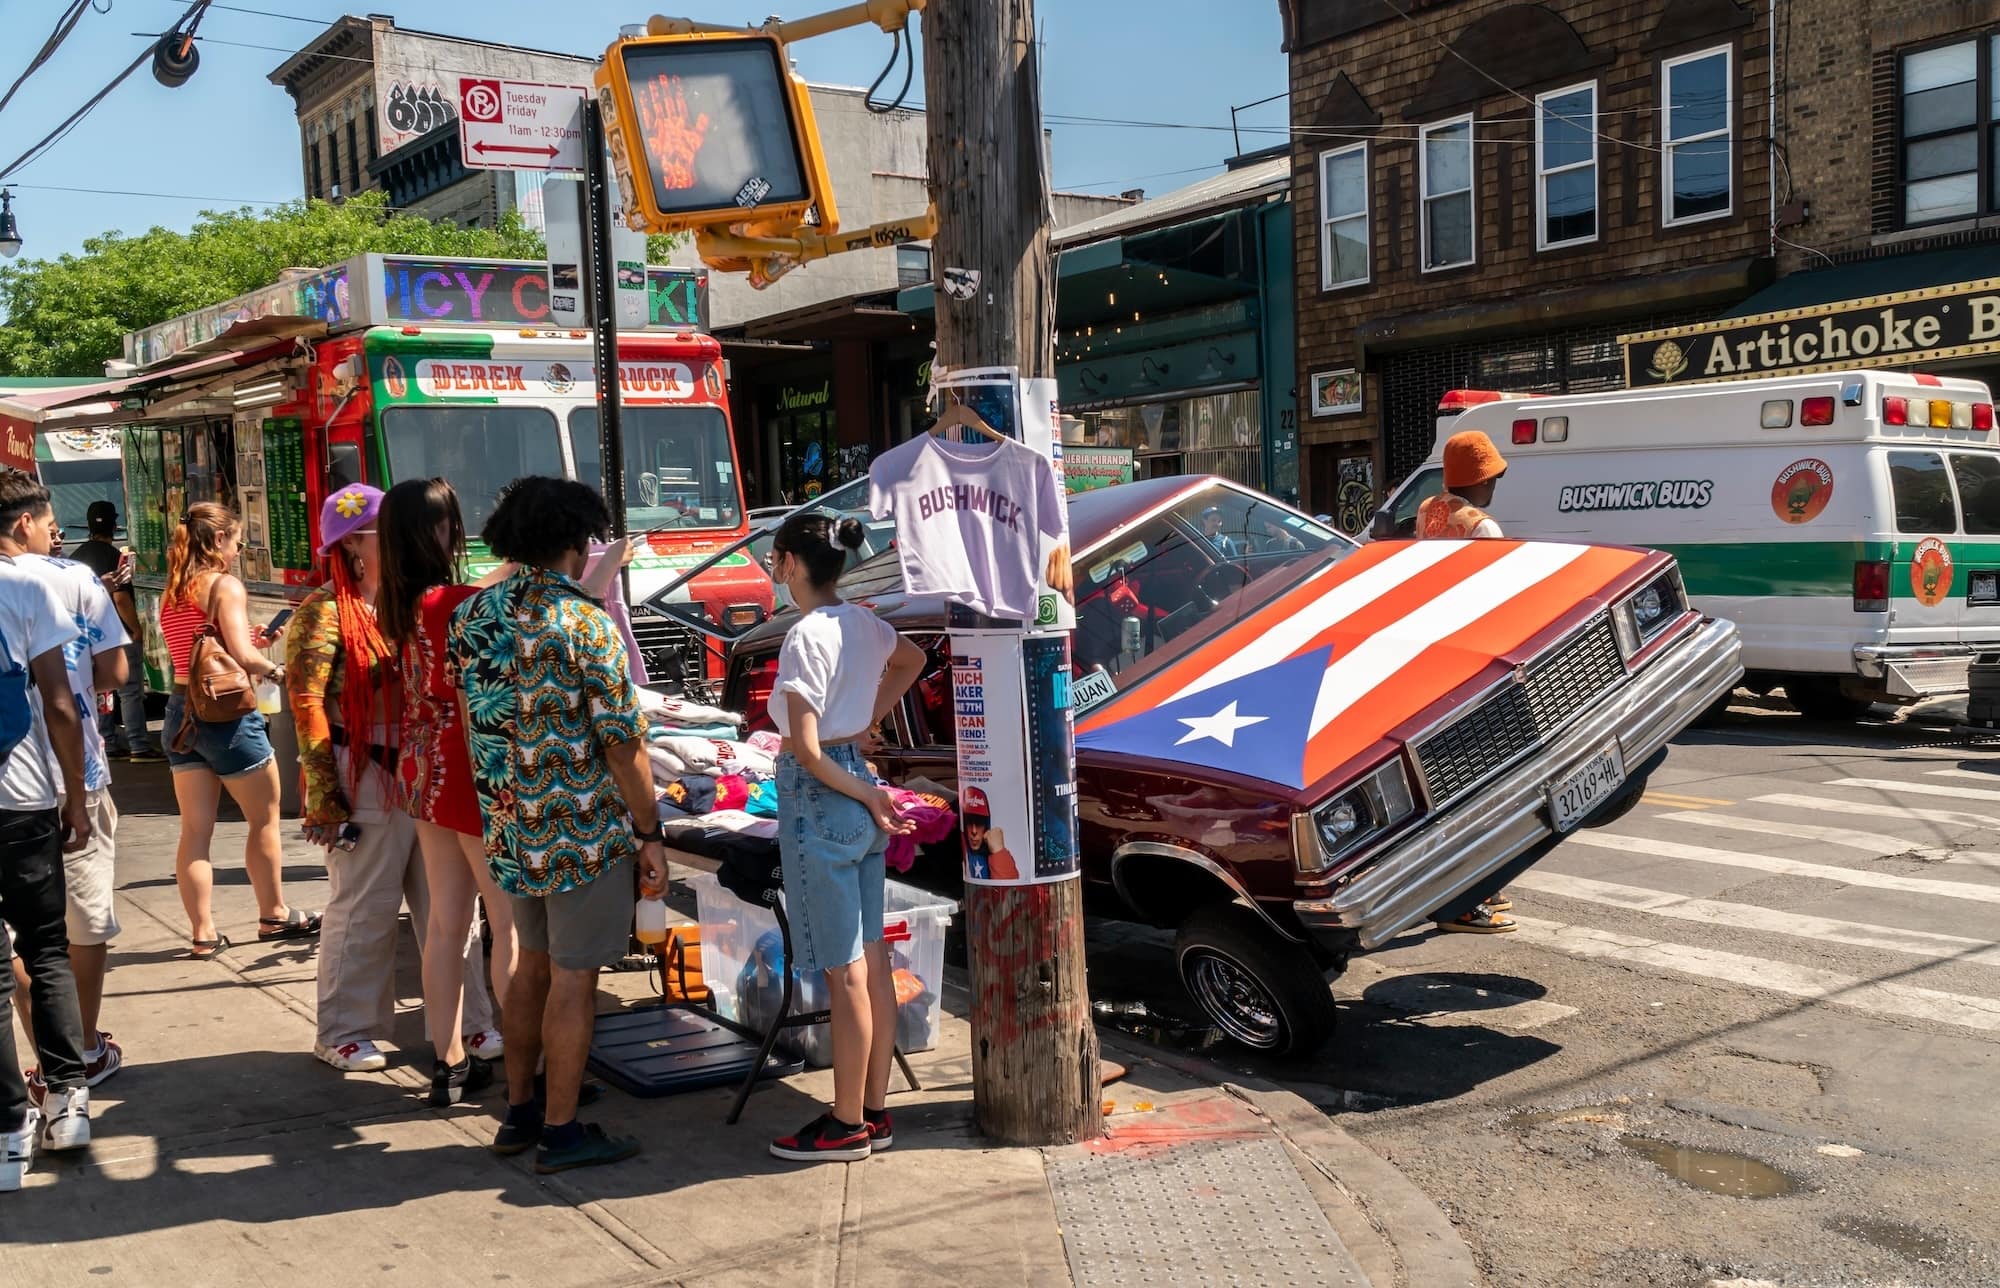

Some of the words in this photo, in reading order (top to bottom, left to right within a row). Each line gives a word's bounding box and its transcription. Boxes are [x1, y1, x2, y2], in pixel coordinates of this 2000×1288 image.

[506, 91, 547, 106] Tuesday
[507, 105, 537, 119] Friday
[508, 124, 532, 136] 11am
[541, 126, 581, 139] 12:30pm
[1703, 308, 1941, 376] Artichoke
[431, 363, 527, 392] DEREK
[593, 366, 681, 392] RUCK
[776, 379, 829, 411] Natural
[1280, 409, 1295, 430] 22
[1091, 455, 1130, 466] MIRANDA
[1779, 460, 1818, 485] BUSHWICK
[1816, 464, 1832, 486] BUDS
[918, 483, 1022, 533] BUSHWICK
[1559, 483, 1656, 512] BUSHWICK
[1656, 480, 1714, 508] BUDS
[1074, 679, 1109, 706] JUAN
[1568, 770, 1585, 786] NEW
